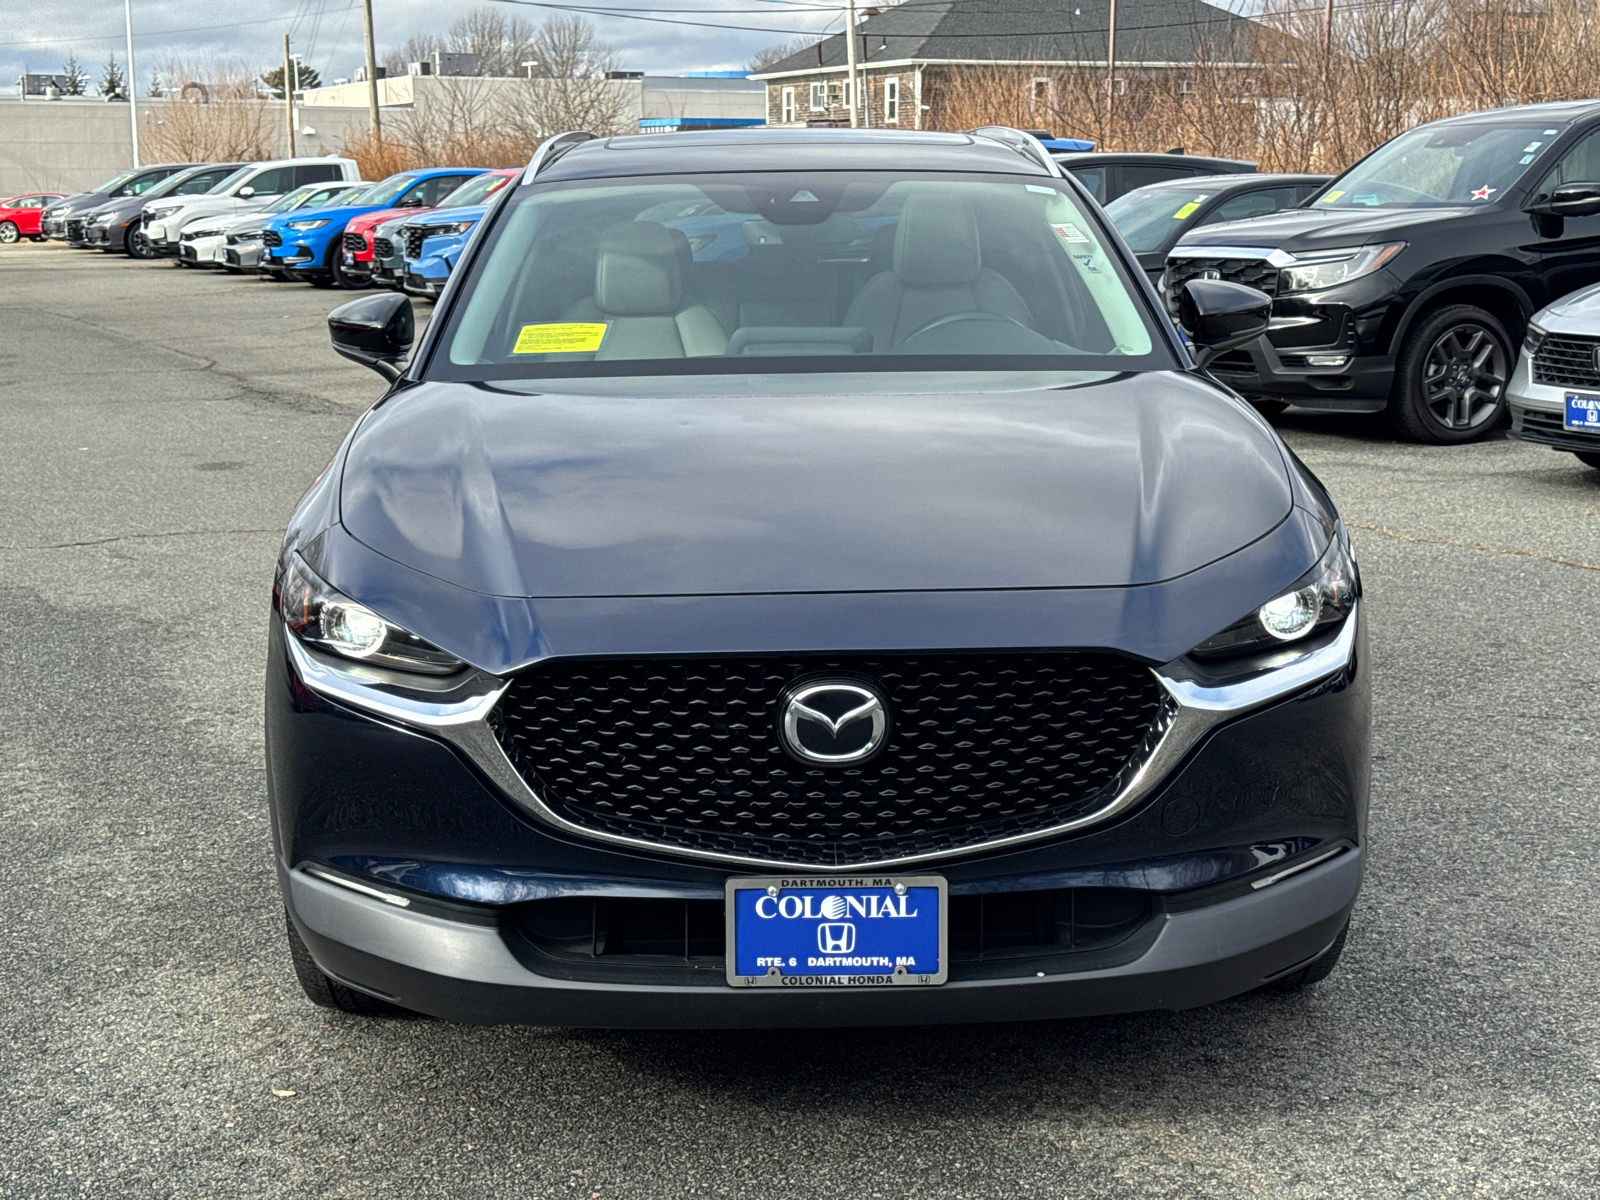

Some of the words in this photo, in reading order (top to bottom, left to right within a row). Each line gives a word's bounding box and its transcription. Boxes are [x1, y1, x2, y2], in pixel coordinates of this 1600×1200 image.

[781, 879, 868, 887] DARTMOUTH,
[873, 878, 892, 886] MA
[755, 895, 918, 920] COLONIAL
[756, 957, 786, 967] RTE.
[788, 957, 798, 967] 6
[807, 957, 893, 968] DARTMOUTH,
[896, 956, 916, 966] MA
[781, 976, 845, 986] COLONIAL
[849, 975, 893, 985] HONDA
